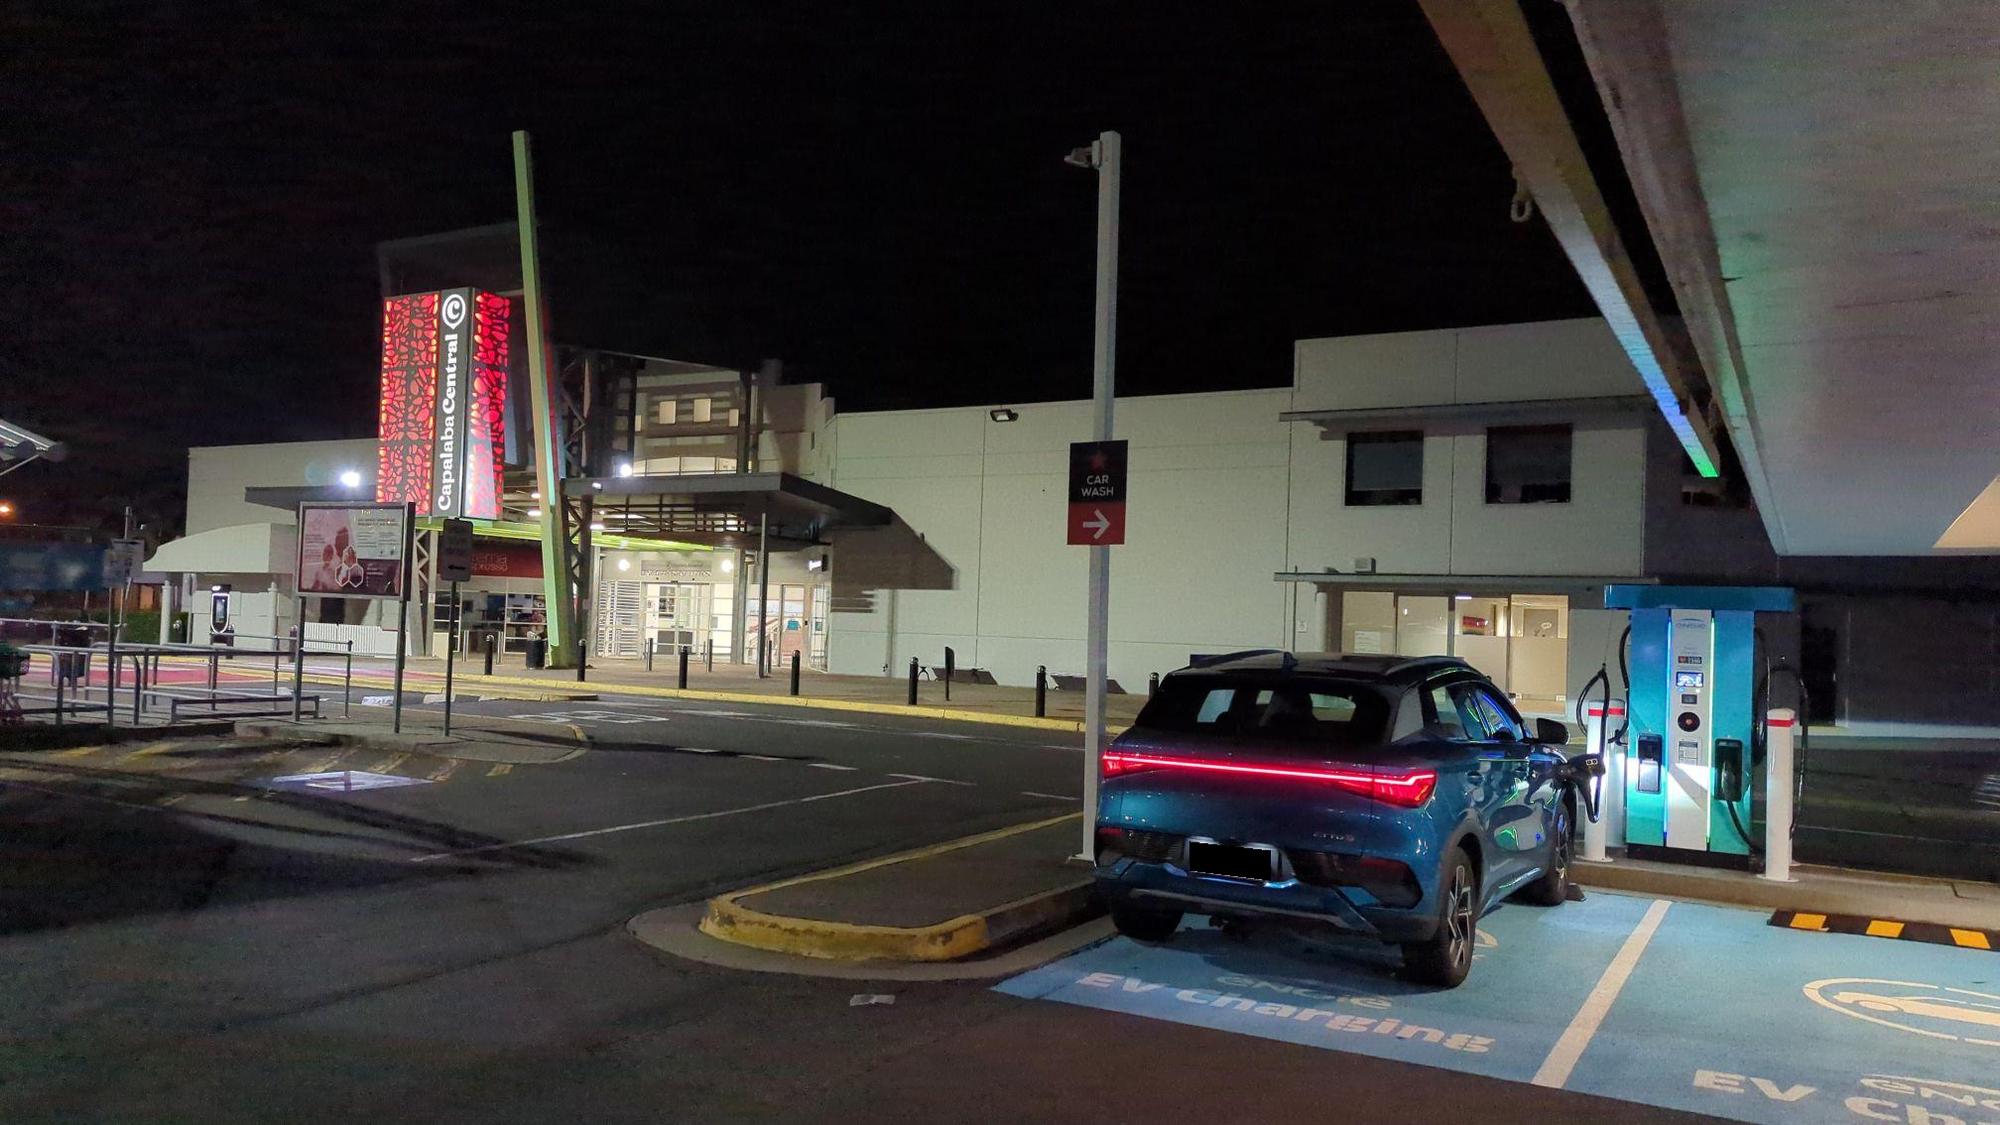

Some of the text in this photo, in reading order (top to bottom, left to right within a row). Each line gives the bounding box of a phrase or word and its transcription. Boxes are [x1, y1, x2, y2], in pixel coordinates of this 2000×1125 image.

[1086, 474, 1110, 485] CAR
[1081, 487, 1115, 497] WASH
[1075, 972, 1496, 1053] EV Charging
[1693, 1069, 1817, 1102] EV
